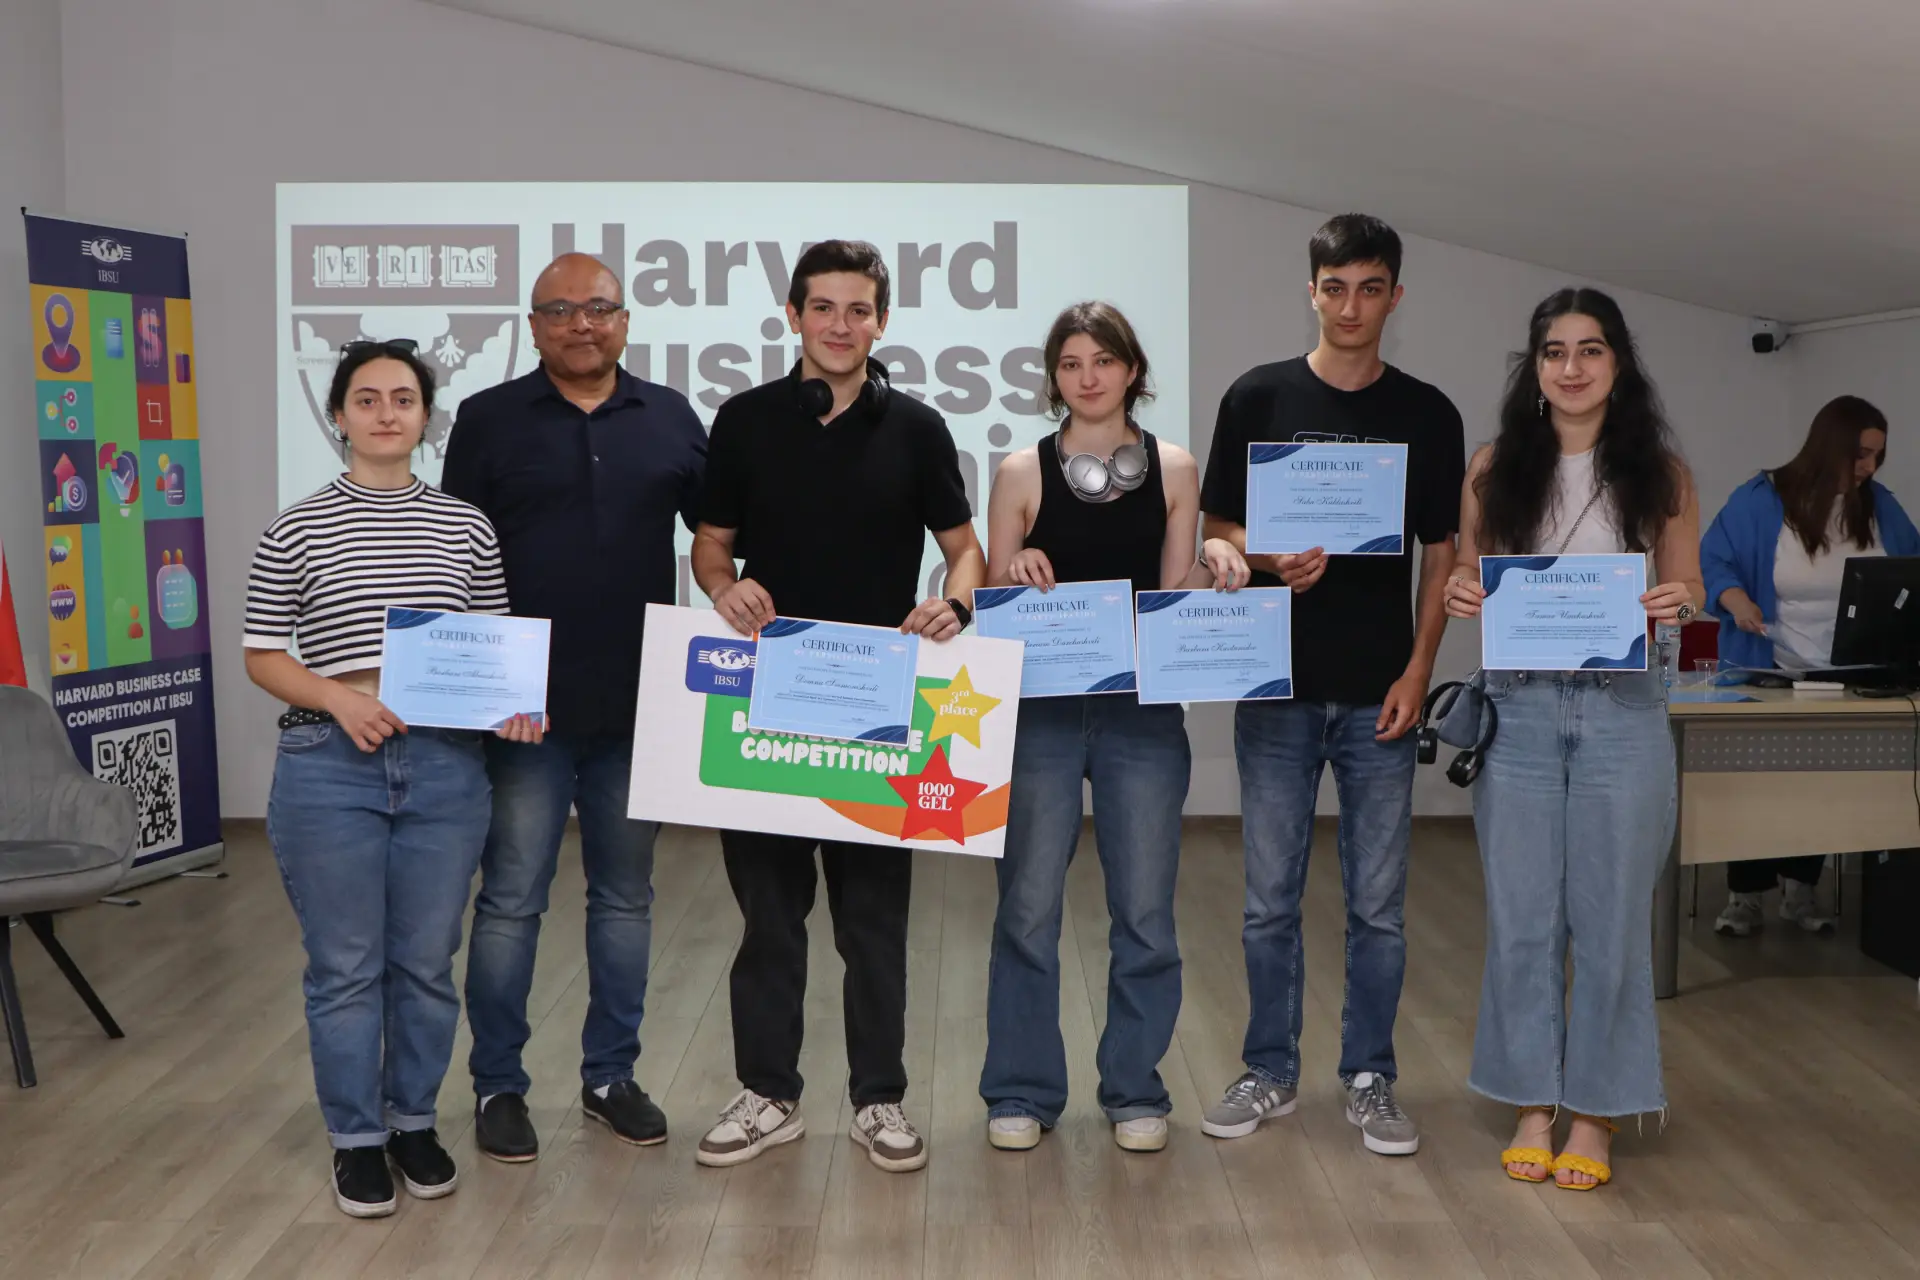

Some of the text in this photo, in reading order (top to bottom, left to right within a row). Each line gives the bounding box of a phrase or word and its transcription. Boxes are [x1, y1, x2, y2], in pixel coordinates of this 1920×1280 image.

[98, 269, 119, 284] IBSU
[624, 317, 1048, 415] usiess
[1291, 461, 1364, 471] CERTIFICATE
[1525, 572, 1601, 584] CERTIFICATE
[1017, 600, 1090, 614] CERTIFICATE
[1178, 606, 1249, 618] CERTIFICATE
[429, 629, 505, 645] CERTIFICATE
[802, 638, 875, 656] CERTIFICATE
[55, 668, 202, 706] HARVARD BUSINESS CASE
[714, 674, 740, 687] IBSU
[950, 689, 970, 704] 3rd
[66, 691, 193, 728] COMPETITION AT IBSU
[939, 703, 978, 717] place
[740, 737, 909, 776] COMPETITION
[918, 781, 955, 797] 1000
[918, 796, 952, 811] GEL
